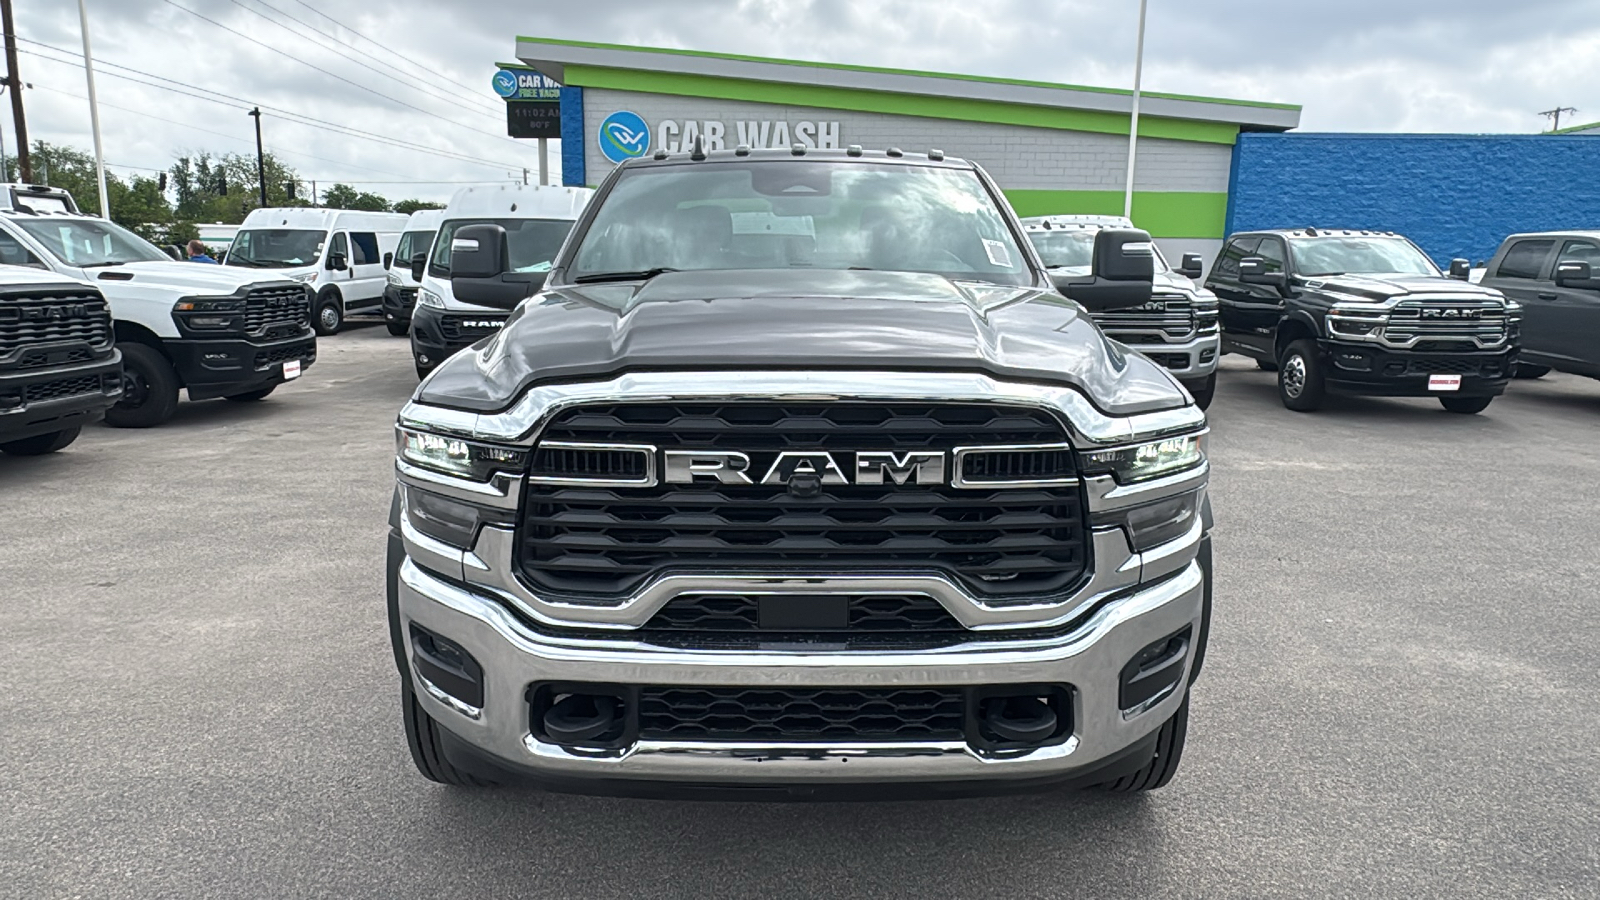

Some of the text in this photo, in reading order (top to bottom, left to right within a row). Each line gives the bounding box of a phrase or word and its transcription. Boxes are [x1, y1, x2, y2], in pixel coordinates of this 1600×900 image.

[518, 75, 541, 88] CAR
[518, 88, 538, 98] FREE
[515, 108, 546, 117] 11:02
[657, 119, 840, 153] CAR WASH
[18, 304, 88, 319] RAM
[1422, 308, 1481, 318] RAM
[664, 450, 946, 485] RAM
